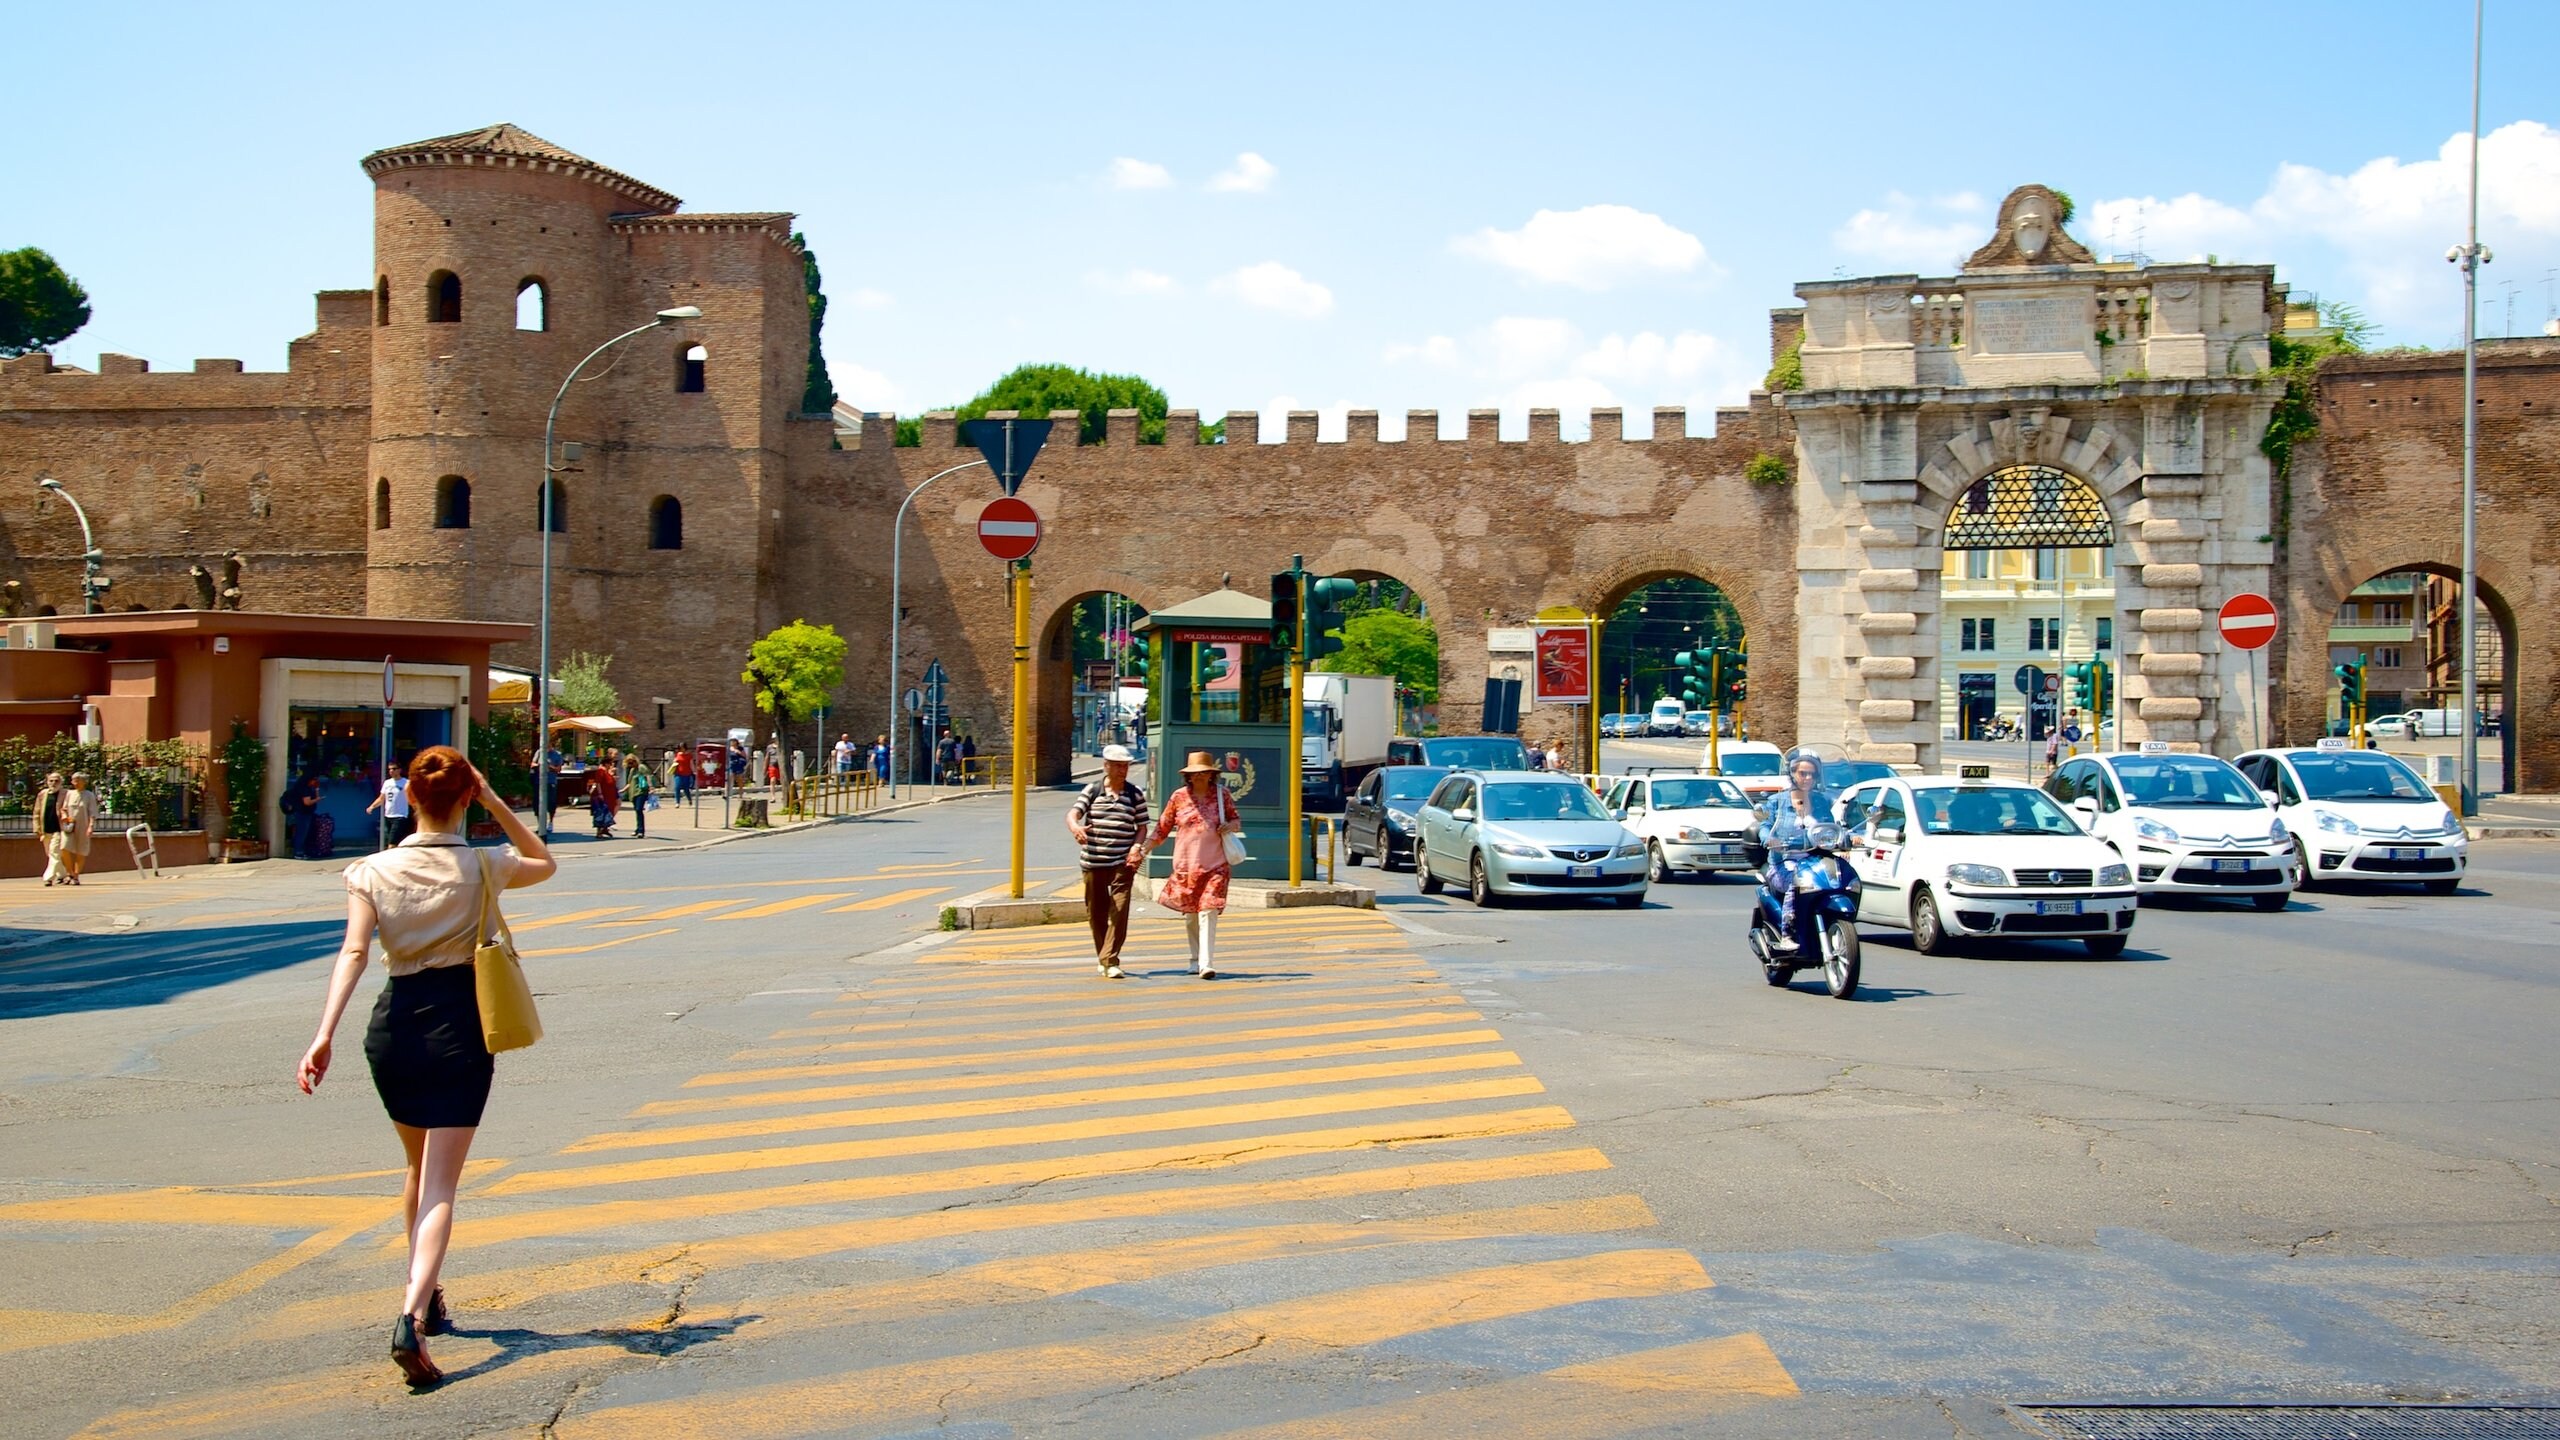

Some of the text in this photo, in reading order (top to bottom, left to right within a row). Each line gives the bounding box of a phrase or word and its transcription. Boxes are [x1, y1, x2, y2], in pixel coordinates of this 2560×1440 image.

[1210, 633, 1230, 641] ROMA
[1230, 634, 1263, 642] CAPITALE
[2144, 742, 2167, 750] TAXI
[1963, 767, 1987, 777] TAXI
